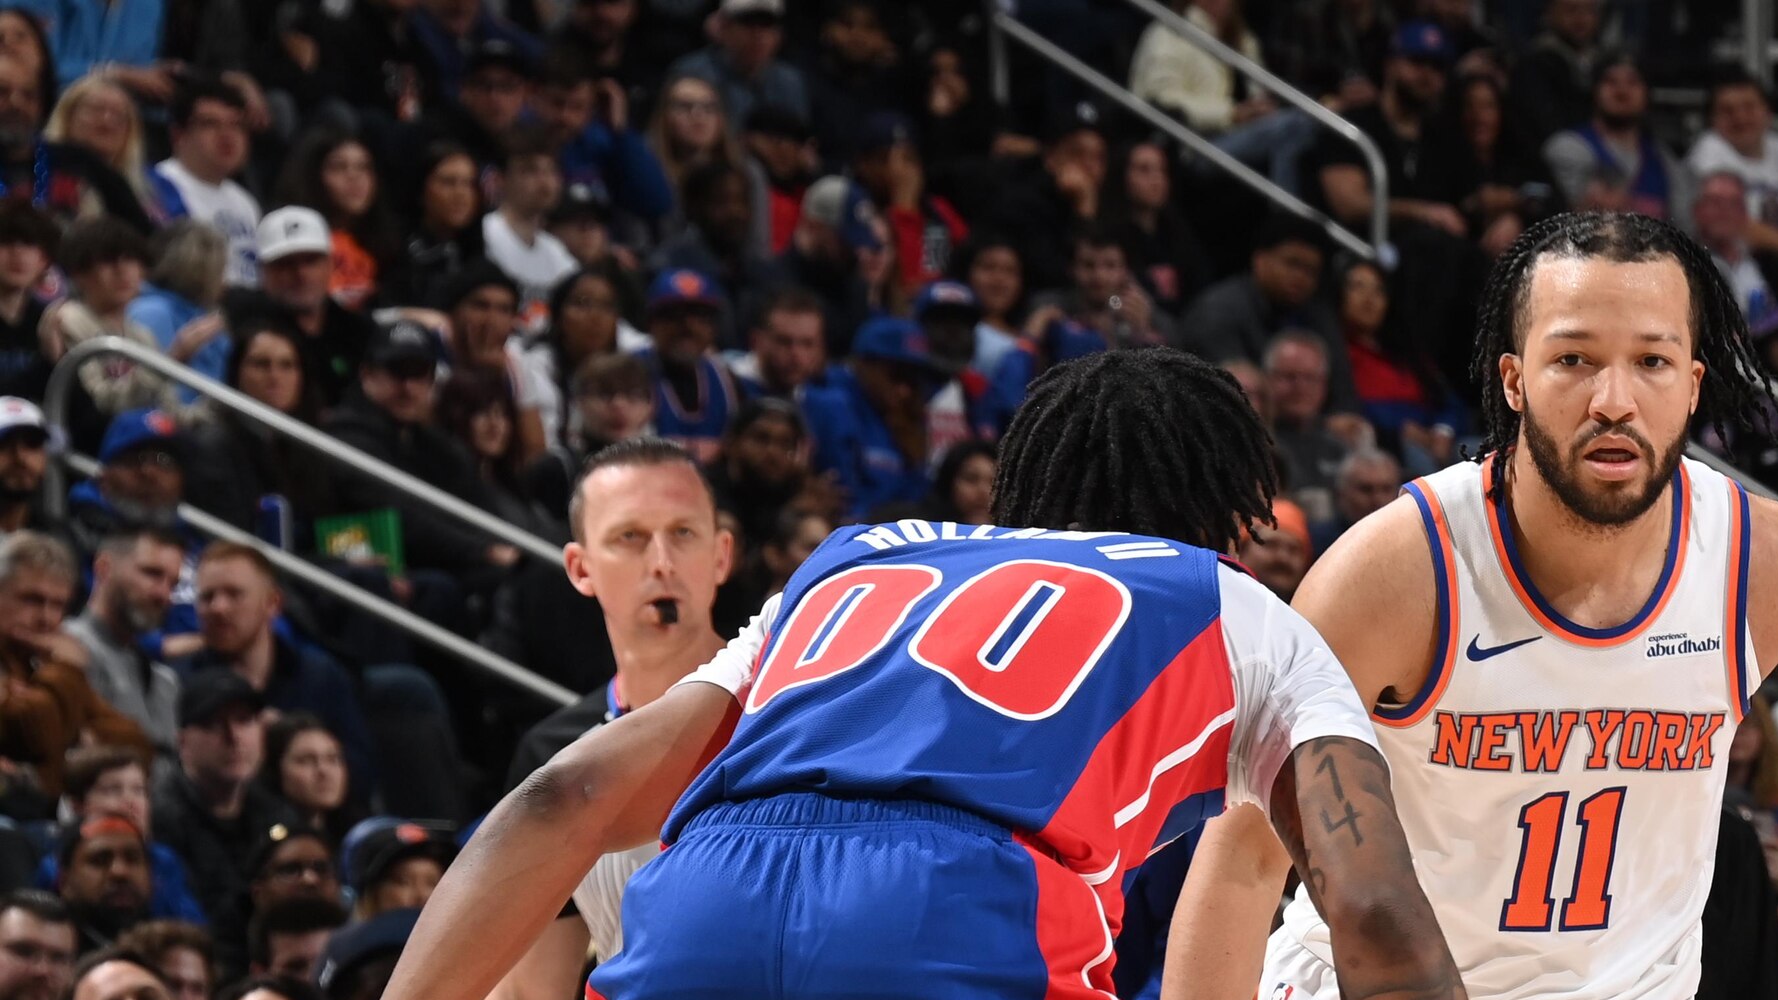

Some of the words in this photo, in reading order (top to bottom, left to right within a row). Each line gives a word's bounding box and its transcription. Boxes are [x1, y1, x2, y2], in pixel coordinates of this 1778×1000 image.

[854, 518, 1130, 550] HOLLA
[745, 559, 1132, 721] 00
[1646, 643, 1676, 658] abu
[1677, 635, 1721, 655] dhabi
[1647, 633, 1688, 643] experience
[1429, 709, 1582, 774] NEW
[1582, 707, 1727, 773] YORK
[1499, 786, 1628, 932] 11
